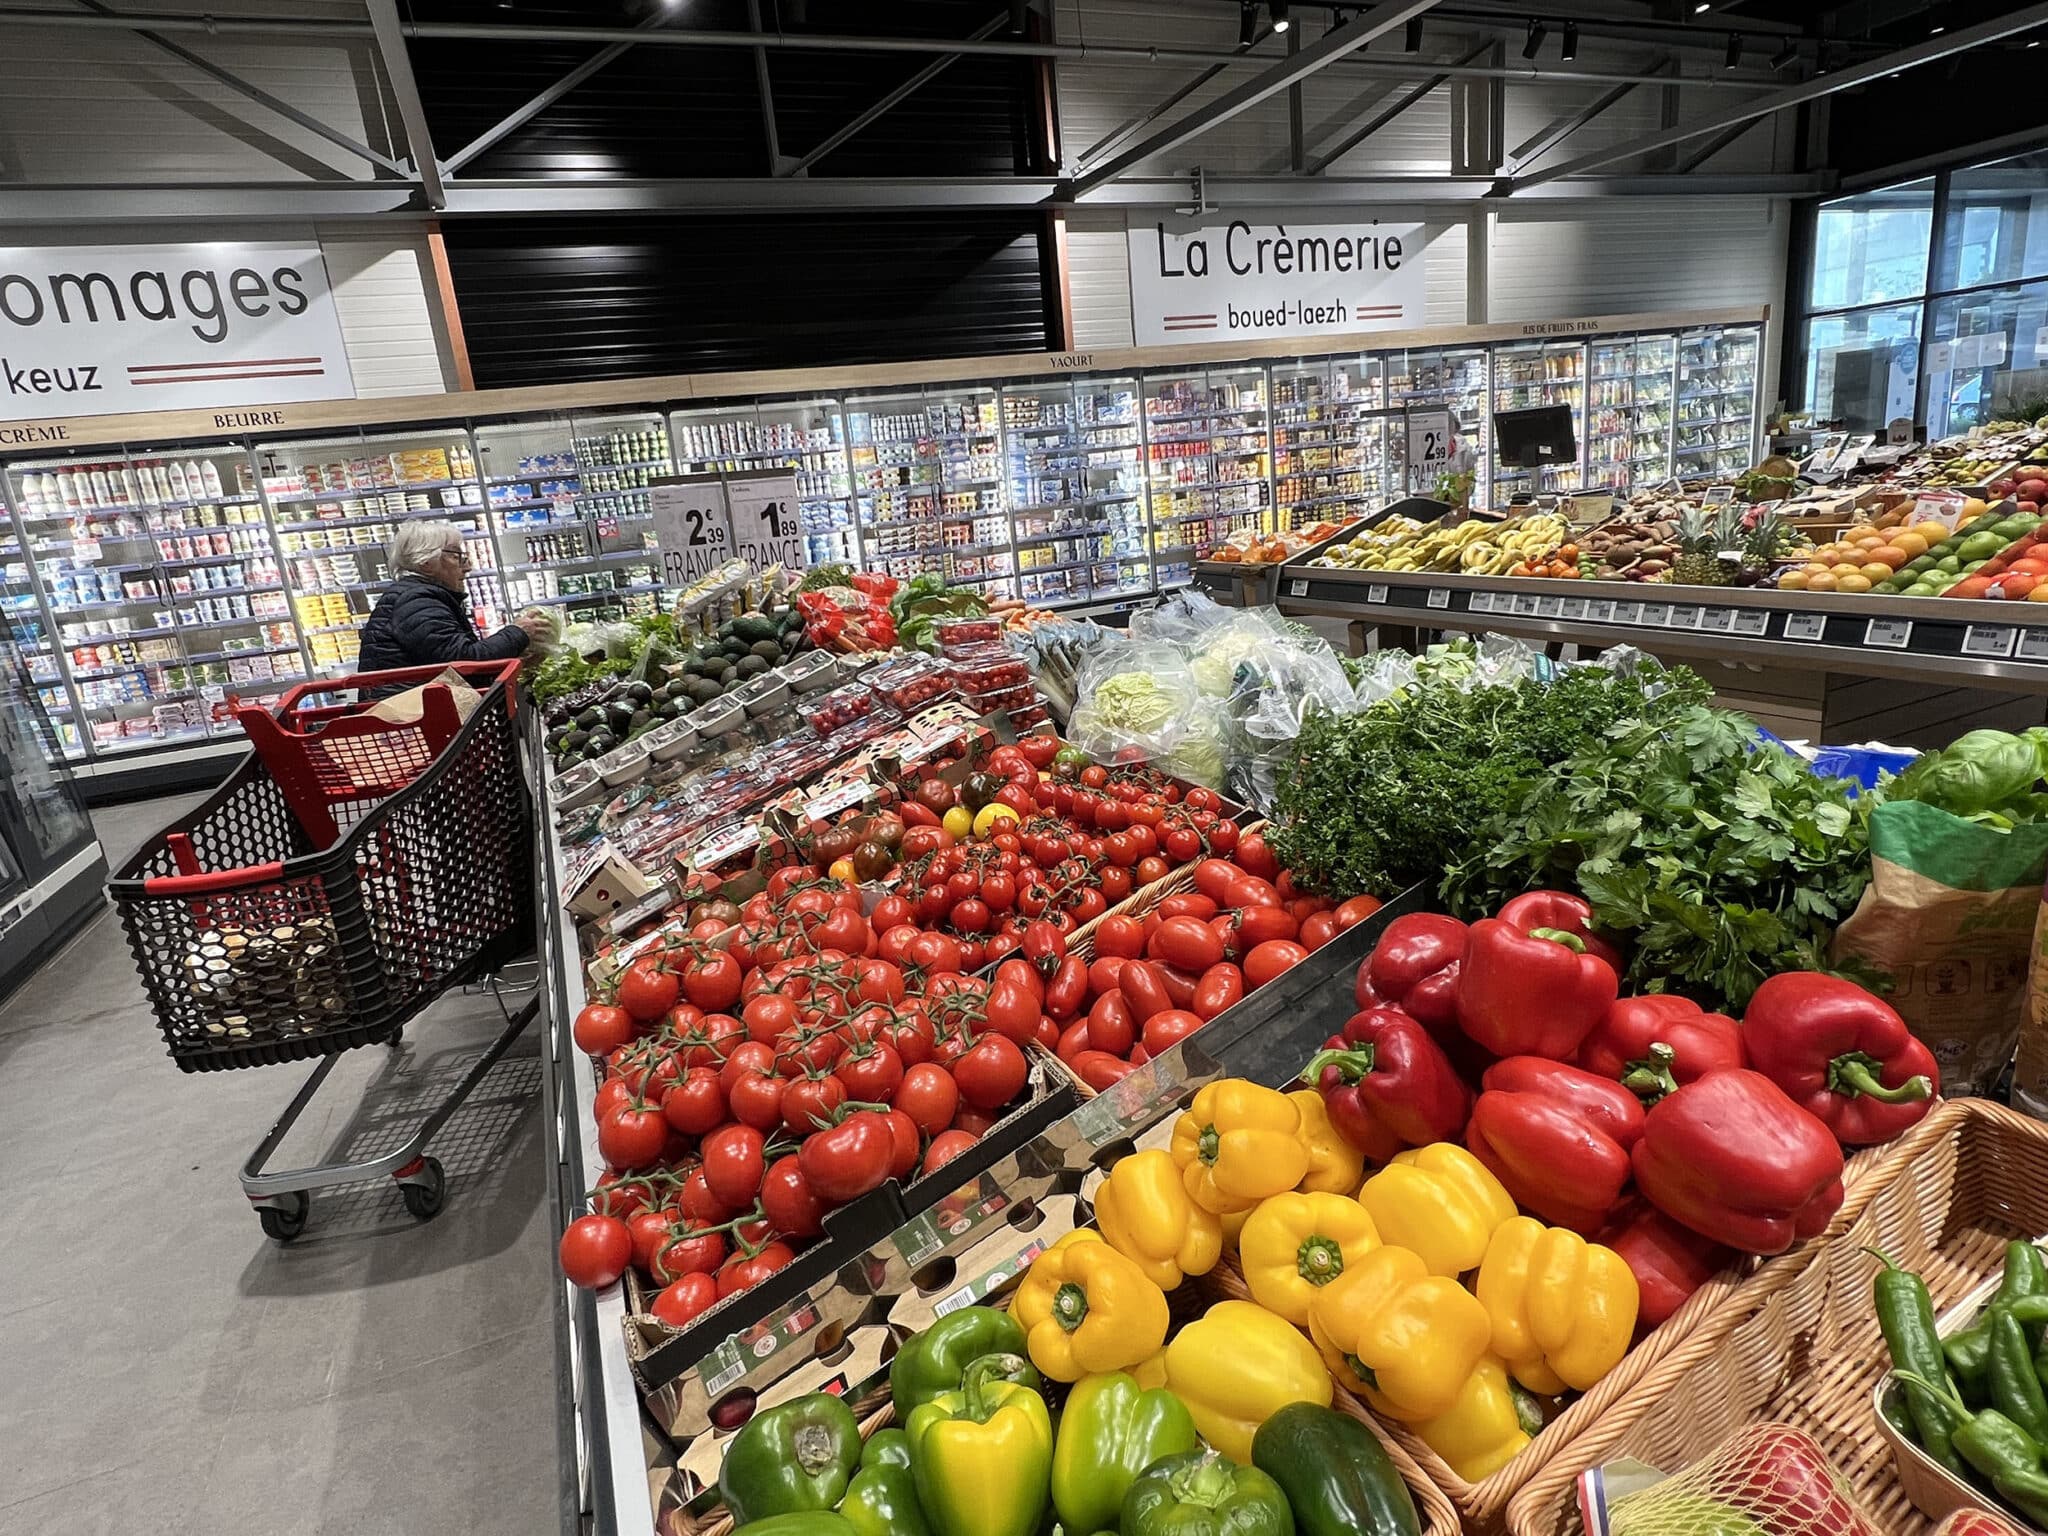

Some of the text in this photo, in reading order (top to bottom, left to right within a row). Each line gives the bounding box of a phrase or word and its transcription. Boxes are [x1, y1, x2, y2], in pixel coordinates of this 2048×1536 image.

[1157, 219, 1402, 277] La Crèmerie
[0, 267, 308, 343] omages
[1228, 298, 1347, 329] boued-laezh
[1536, 323, 1547, 334] DE
[1548, 322, 1575, 333] FRUITS
[1577, 320, 1599, 331] FRAIS
[1050, 354, 1094, 369] YAOURT
[1, 357, 102, 394] keuz
[214, 410, 285, 429] BEURRE
[0, 424, 70, 444] CRÈME
